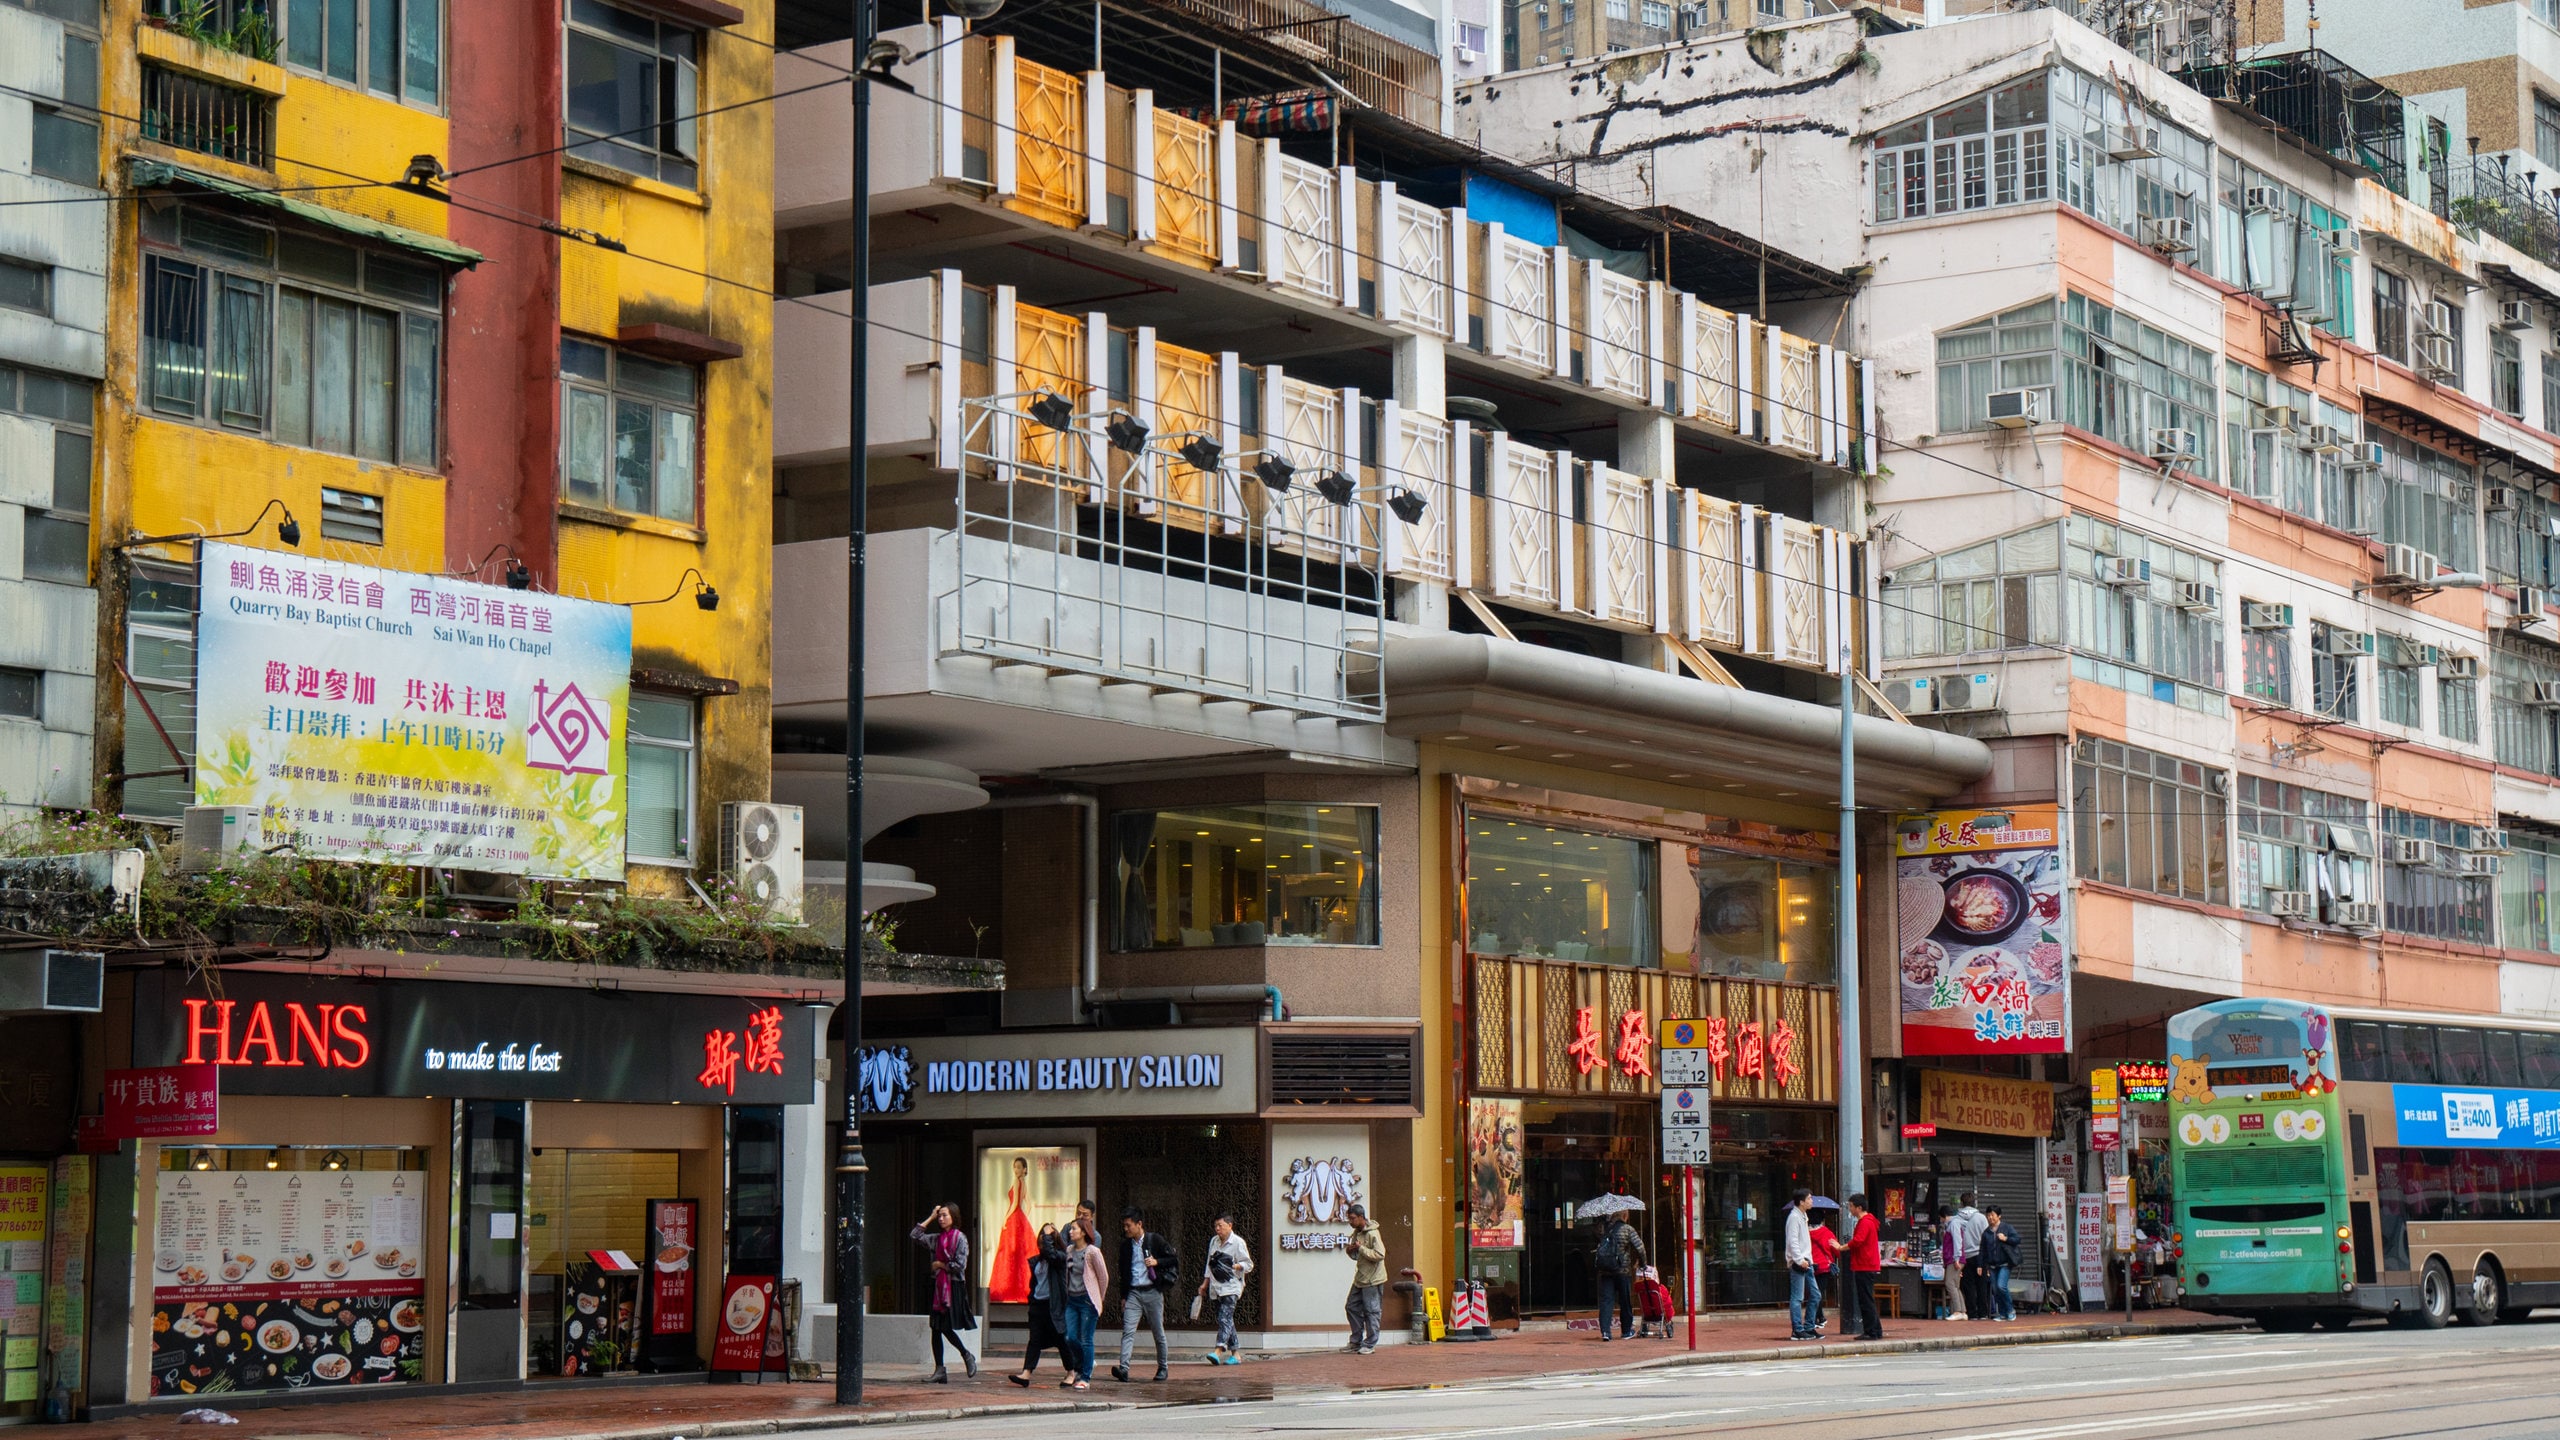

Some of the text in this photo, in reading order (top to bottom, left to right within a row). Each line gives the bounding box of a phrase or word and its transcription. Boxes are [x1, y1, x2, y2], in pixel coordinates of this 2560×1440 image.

[229, 560, 553, 634] 鰂魚涌浸信會 西灣河福音堂
[229, 595, 552, 657] Quarry Bay Baptist Church Sai Wan Ho Chapel
[264, 660, 507, 721] 歡迎參加 共沐主恩
[1933, 822, 1980, 849] 長發
[485, 847, 506, 860] 2513
[508, 850, 530, 862] 1000
[1975, 1008, 2061, 1041] 海鮮 料理
[181, 998, 372, 1069] HANS
[2227, 1034, 2263, 1044] Winnie
[1569, 1006, 1801, 1088] 長發鮮酒家
[2234, 1043, 2260, 1055] Pooh
[425, 1042, 563, 1073] to make the best
[1669, 1051, 1699, 1063] 上午 7
[927, 1053, 1223, 1094] MODERN BEAUTY SALON
[1691, 1070, 1706, 1082] 12
[2271, 1067, 2288, 1083] 613
[1956, 1105, 2026, 1130] 28508640
[2506, 1097, 2531, 1129] 機票
[1670, 1131, 1700, 1143] 上午 7
[1665, 1148, 1690, 1156] midnight
[1692, 1150, 1707, 1162] 12
[2050, 1153, 2074, 1166] 出租
[2079, 1206, 2100, 1219] 有房
[2079, 1222, 2100, 1235] 出租
[1281, 1232, 1353, 1251] 現代美容中
[2079, 1238, 2100, 1246] ROOM
[2082, 1246, 2098, 1254] FOR
[2080, 1254, 2100, 1262] RENT
